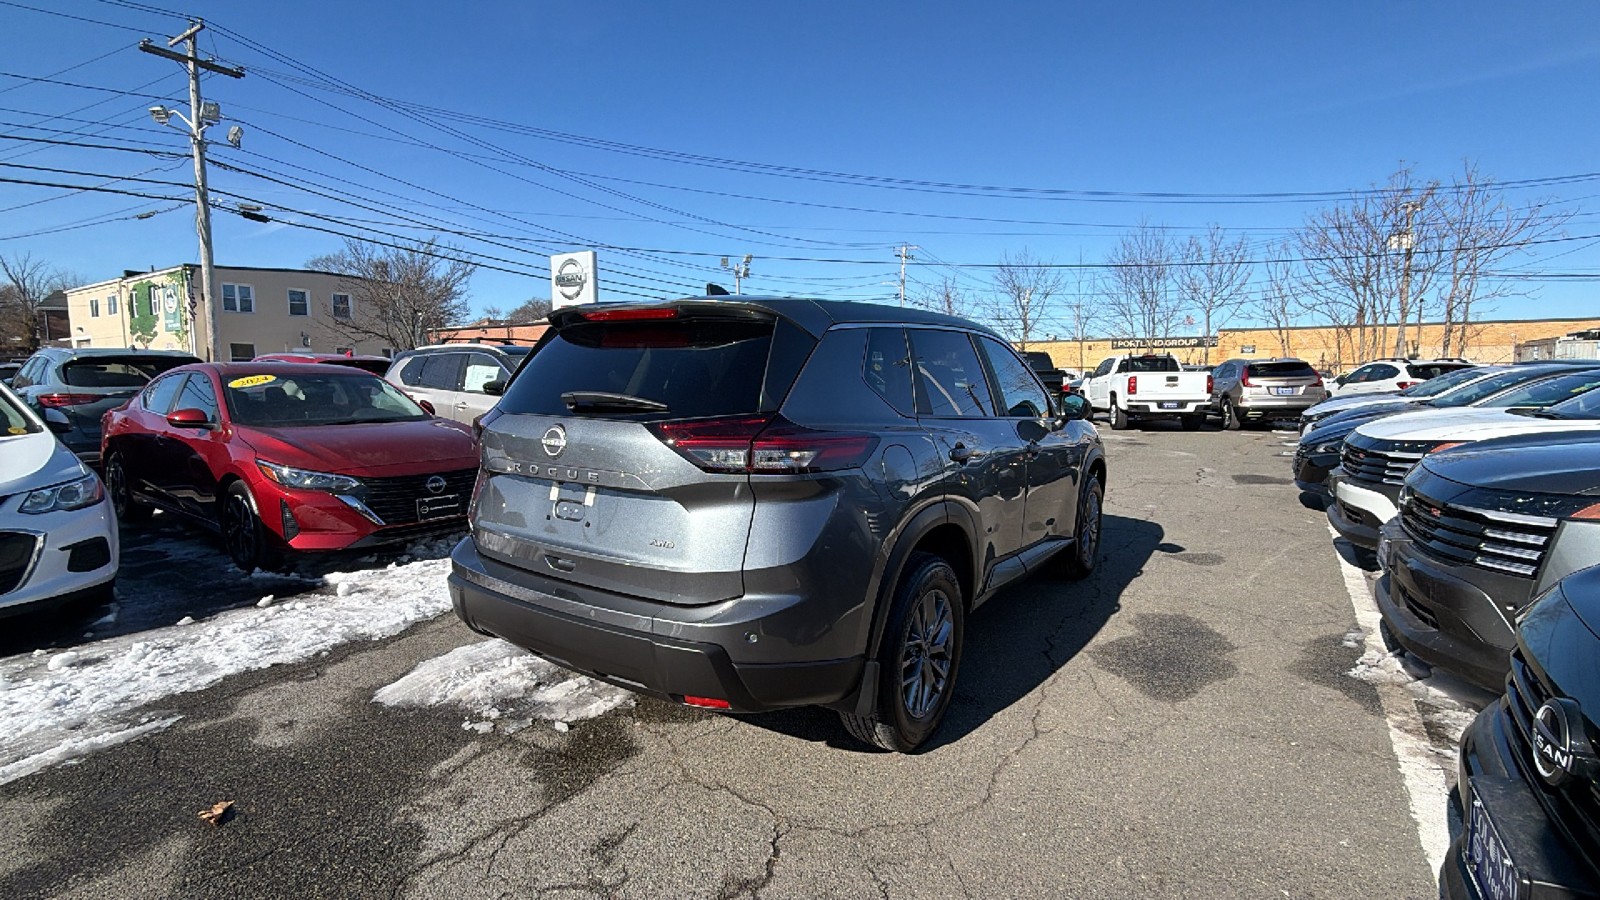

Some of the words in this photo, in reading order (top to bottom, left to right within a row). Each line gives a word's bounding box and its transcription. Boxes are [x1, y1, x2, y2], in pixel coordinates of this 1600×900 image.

[557, 274, 583, 283] NISSAN
[1117, 339, 1164, 348] PORTLAND
[1164, 338, 1198, 347] GROUP
[237, 376, 269, 386] 2024
[513, 462, 599, 482] ROGUE
[649, 539, 675, 549] AWD
